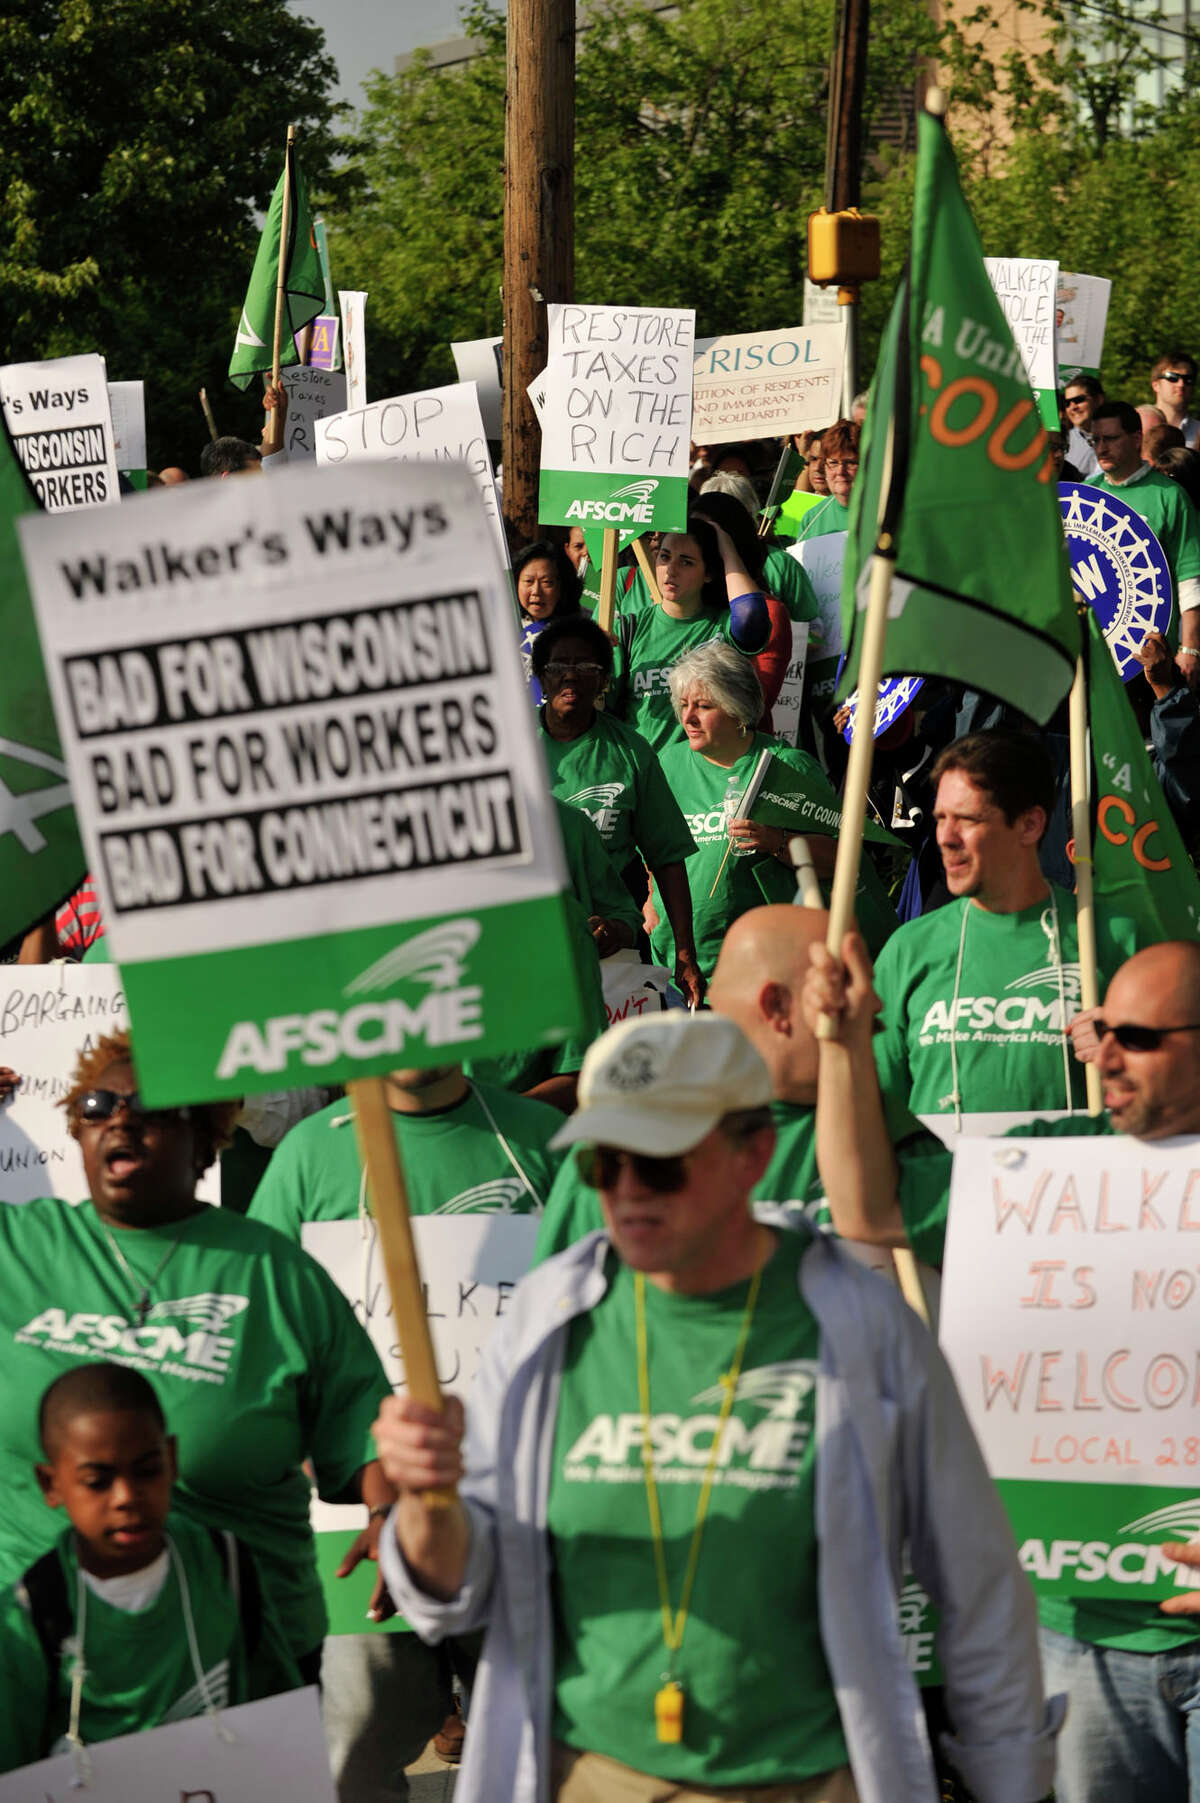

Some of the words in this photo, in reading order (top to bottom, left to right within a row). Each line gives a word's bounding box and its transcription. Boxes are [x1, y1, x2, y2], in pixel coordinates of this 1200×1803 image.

[562, 307, 692, 348] RESTORE
[994, 294, 1049, 324] TOLE
[1023, 325, 1049, 345] THE
[562, 350, 679, 385] TAXES
[740, 383, 760, 395] OF
[764, 375, 830, 393] RESIDENTS
[29, 387, 89, 411] Ways
[567, 387, 613, 419] ON
[628, 390, 690, 426] THE
[722, 392, 805, 410] IMMIGRANTS
[324, 397, 443, 463] STOP
[571, 423, 680, 468] RICH
[564, 499, 655, 523] AFSCME
[60, 523, 289, 599] Walker's
[305, 502, 449, 556] Ways
[68, 650, 157, 731] BAD
[157, 637, 252, 720] FOR
[246, 596, 485, 708] WISCONSIN
[91, 746, 174, 813] BAD
[189, 730, 275, 800] FOR
[282, 694, 497, 786] WORKERS
[758, 790, 801, 812] AFSCME
[103, 828, 183, 907] BAD
[180, 818, 263, 898] FOR
[259, 778, 517, 886] CONNECTICUT
[215, 985, 484, 1080] AFSCME
[936, 1030, 970, 1044] Make
[972, 1031, 1028, 1044] America
[0, 1147, 65, 1172] UNION
[1020, 1259, 1098, 1311] IS
[15, 1308, 236, 1372] AFSCME
[980, 1348, 1200, 1413] WELCO
[564, 1413, 810, 1471] AFSCME
[1029, 1434, 1142, 1465] LOCAL
[1020, 1538, 1200, 1590] AFSCM
